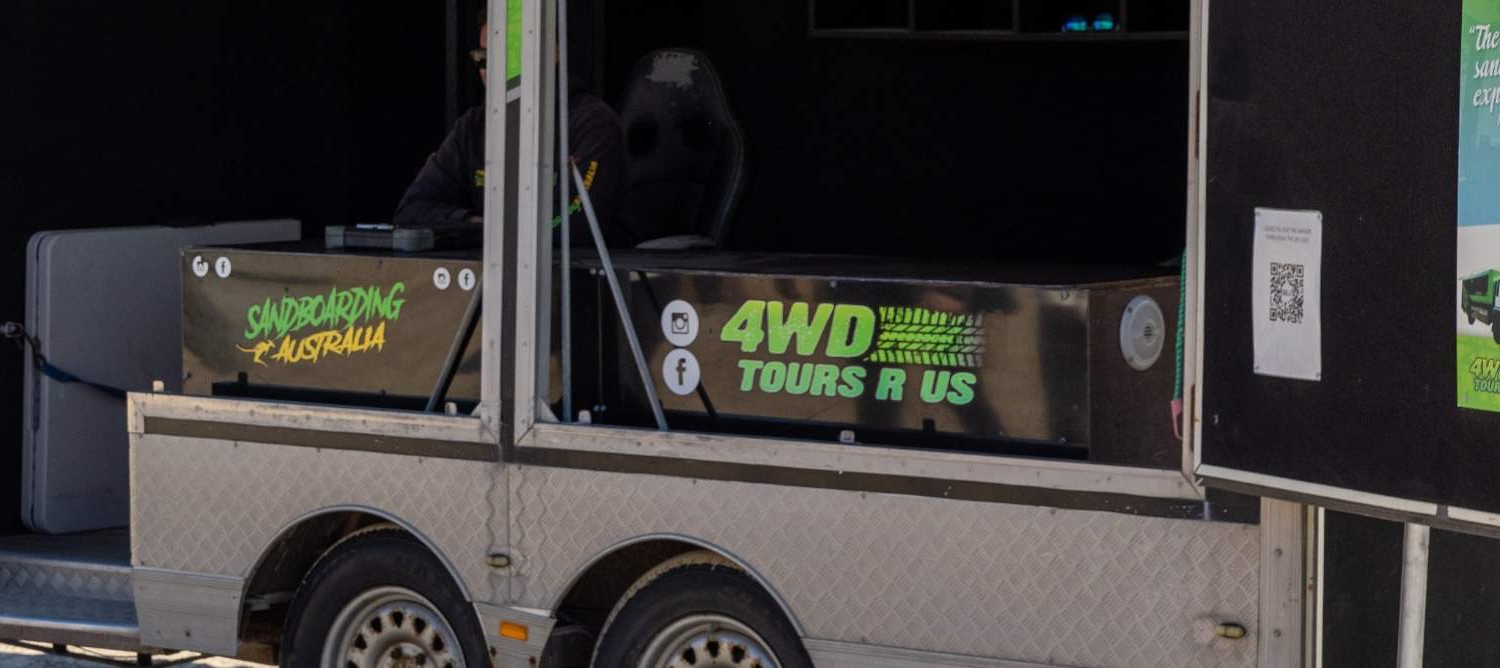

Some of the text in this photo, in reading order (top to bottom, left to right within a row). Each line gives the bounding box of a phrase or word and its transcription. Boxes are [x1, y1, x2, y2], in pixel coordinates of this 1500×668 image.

[1473, 58, 1500, 79] san
[1473, 86, 1500, 113] exp
[244, 281, 407, 340] SANDBOARDING
[270, 320, 386, 364] AUSTRALIA
[720, 299, 876, 358] 4WD
[738, 359, 977, 405] TOURS R US
[1468, 357, 1500, 380] 4W
[1473, 379, 1500, 393] TOUR
